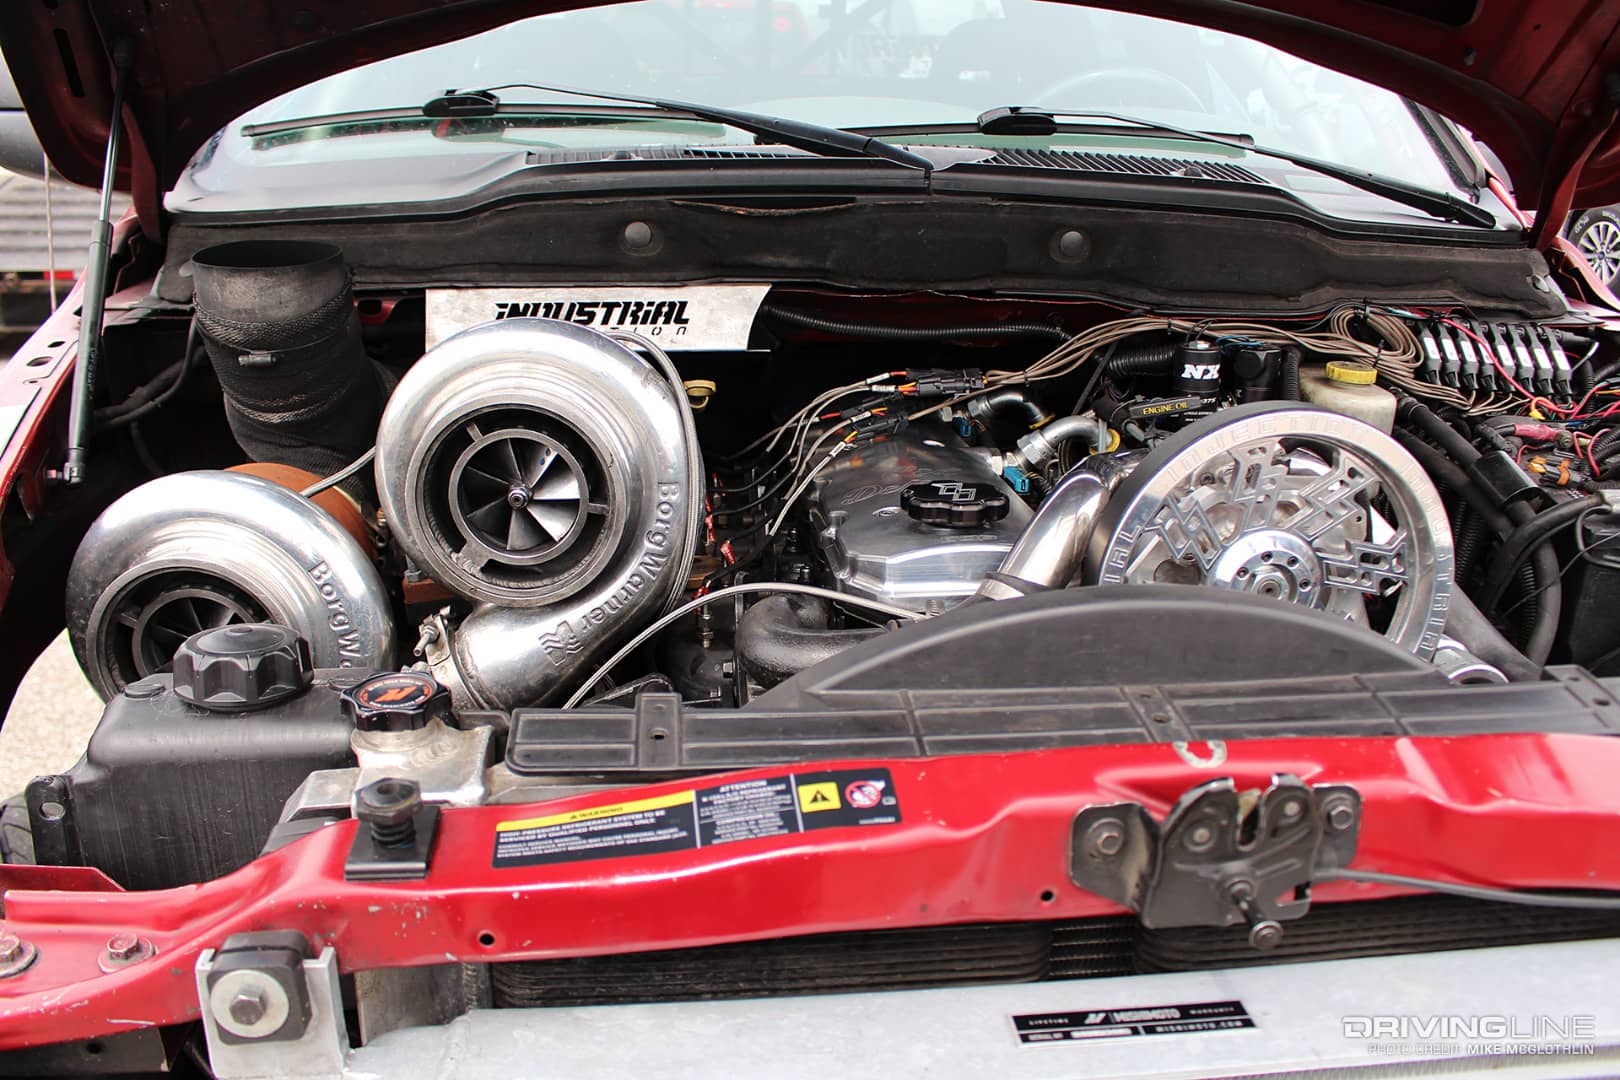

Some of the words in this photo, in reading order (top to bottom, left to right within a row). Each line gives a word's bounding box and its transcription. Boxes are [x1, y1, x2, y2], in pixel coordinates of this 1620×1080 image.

[1181, 363, 1220, 380] NX
[1143, 403, 1173, 415] ENGINE
[581, 481, 680, 632] BorgWarner
